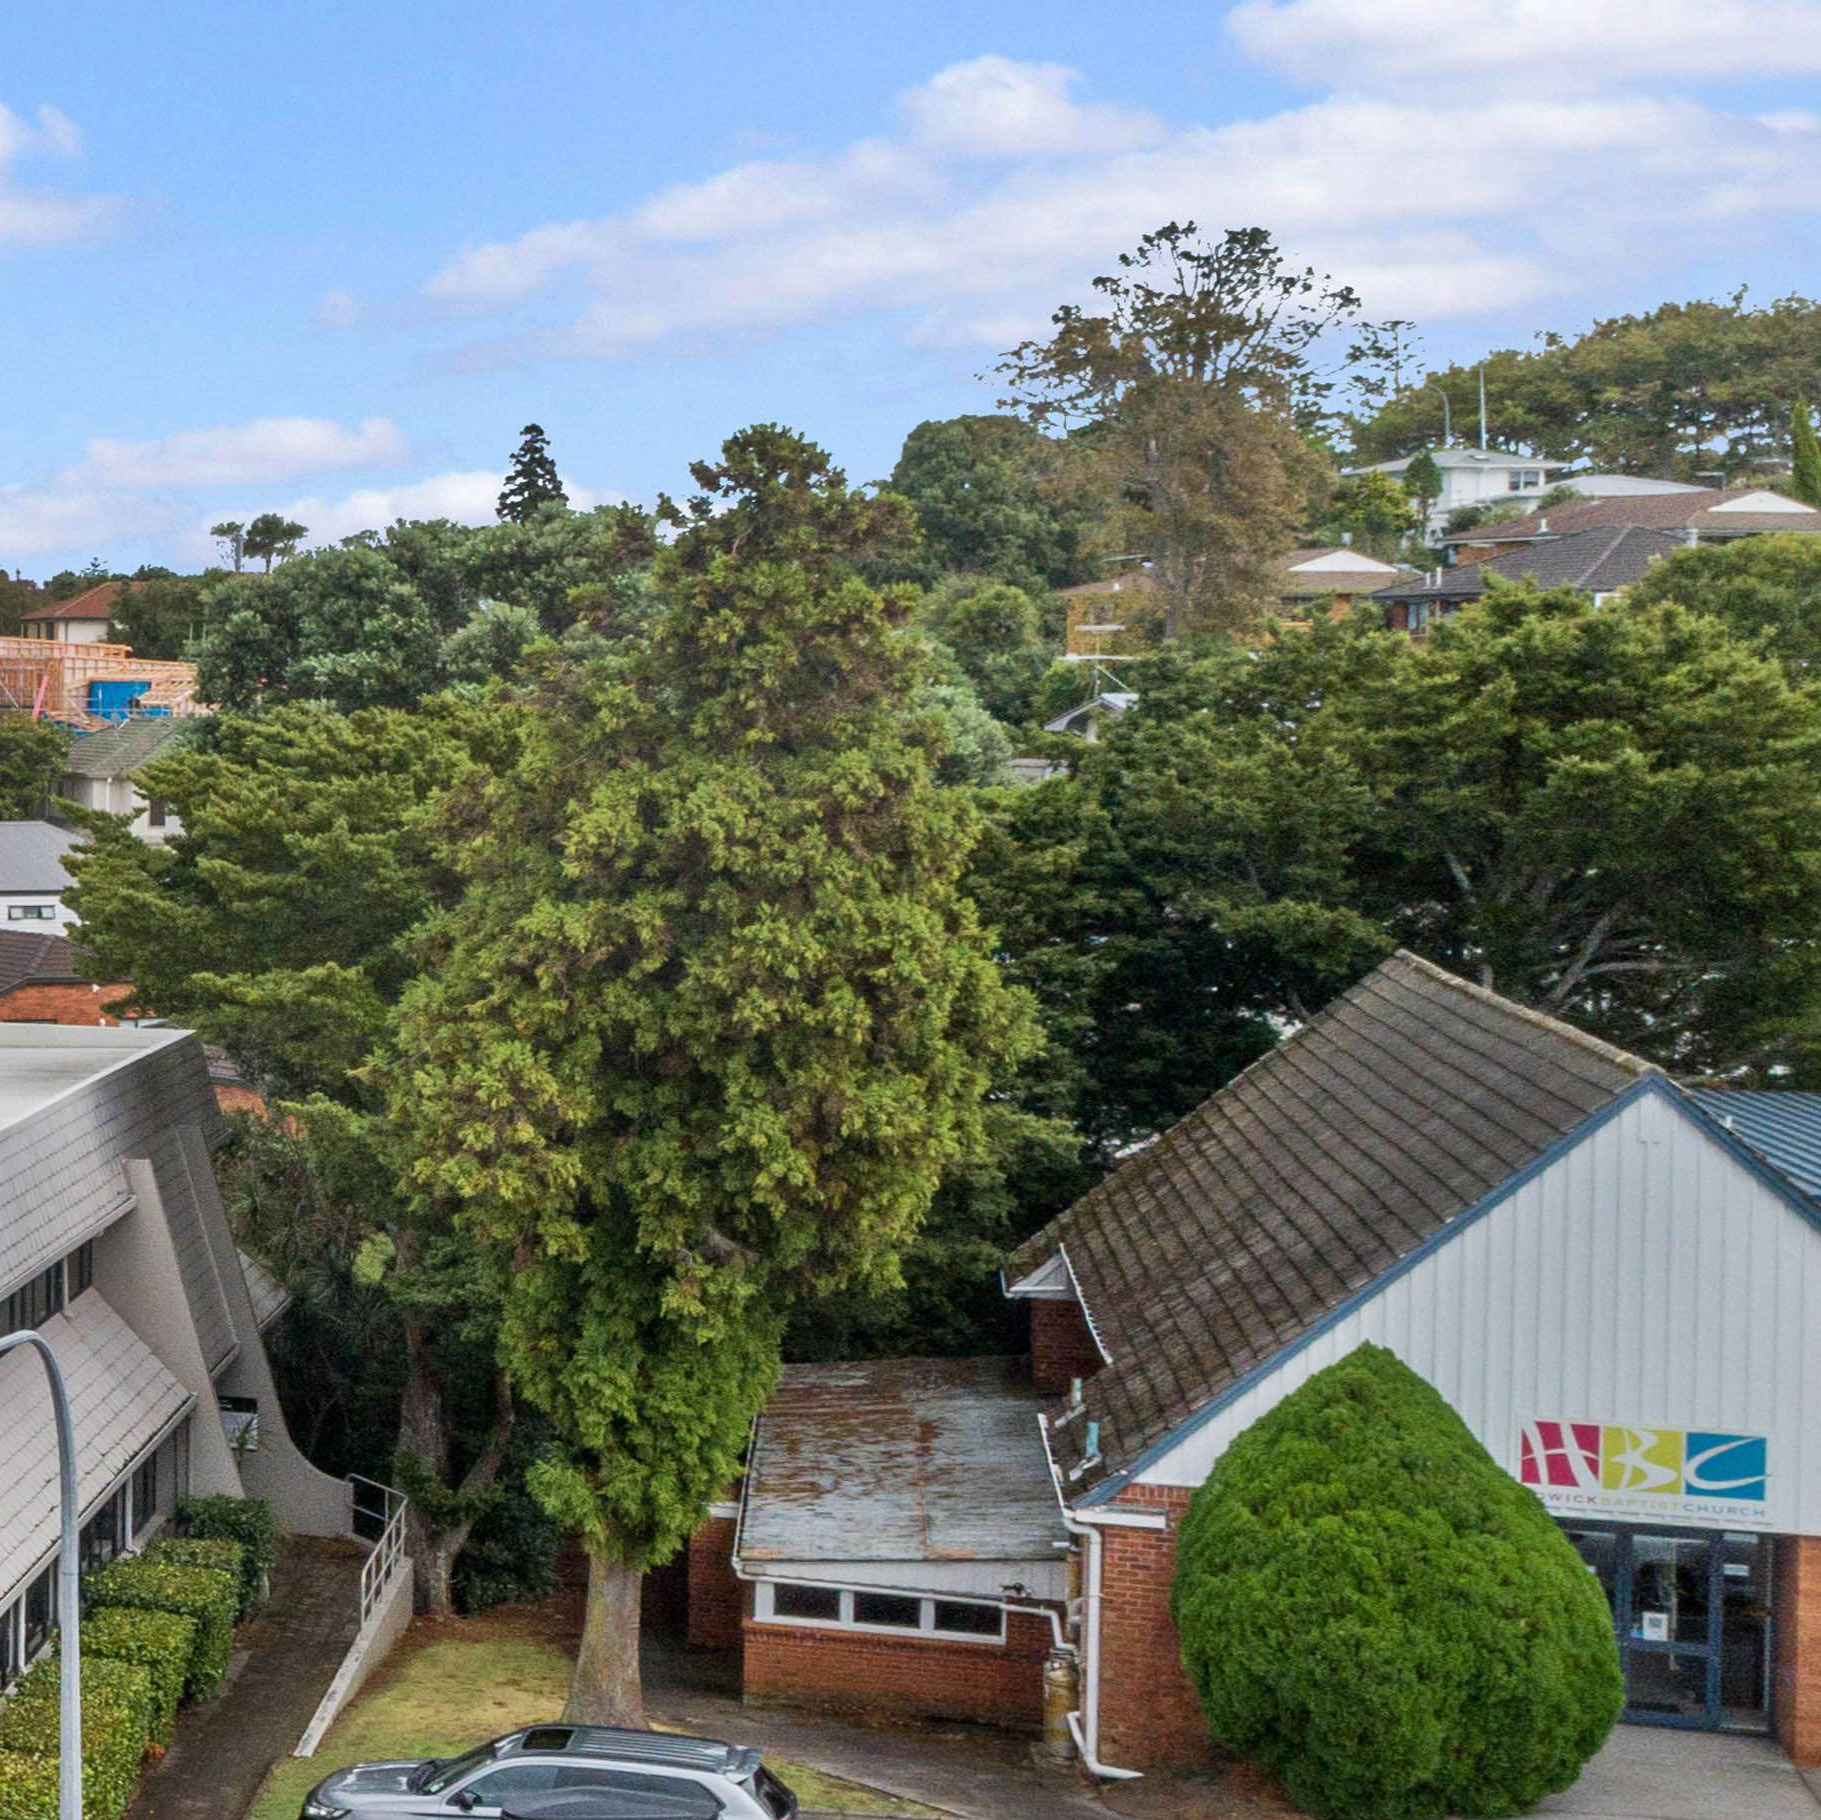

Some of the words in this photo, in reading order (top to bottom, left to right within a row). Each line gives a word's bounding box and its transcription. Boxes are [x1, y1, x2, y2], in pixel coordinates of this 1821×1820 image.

[1535, 1492, 1598, 1505] OWICK
[1601, 1497, 1680, 1513] BAPTIST
[1682, 1503, 1766, 1517] CHURCH
